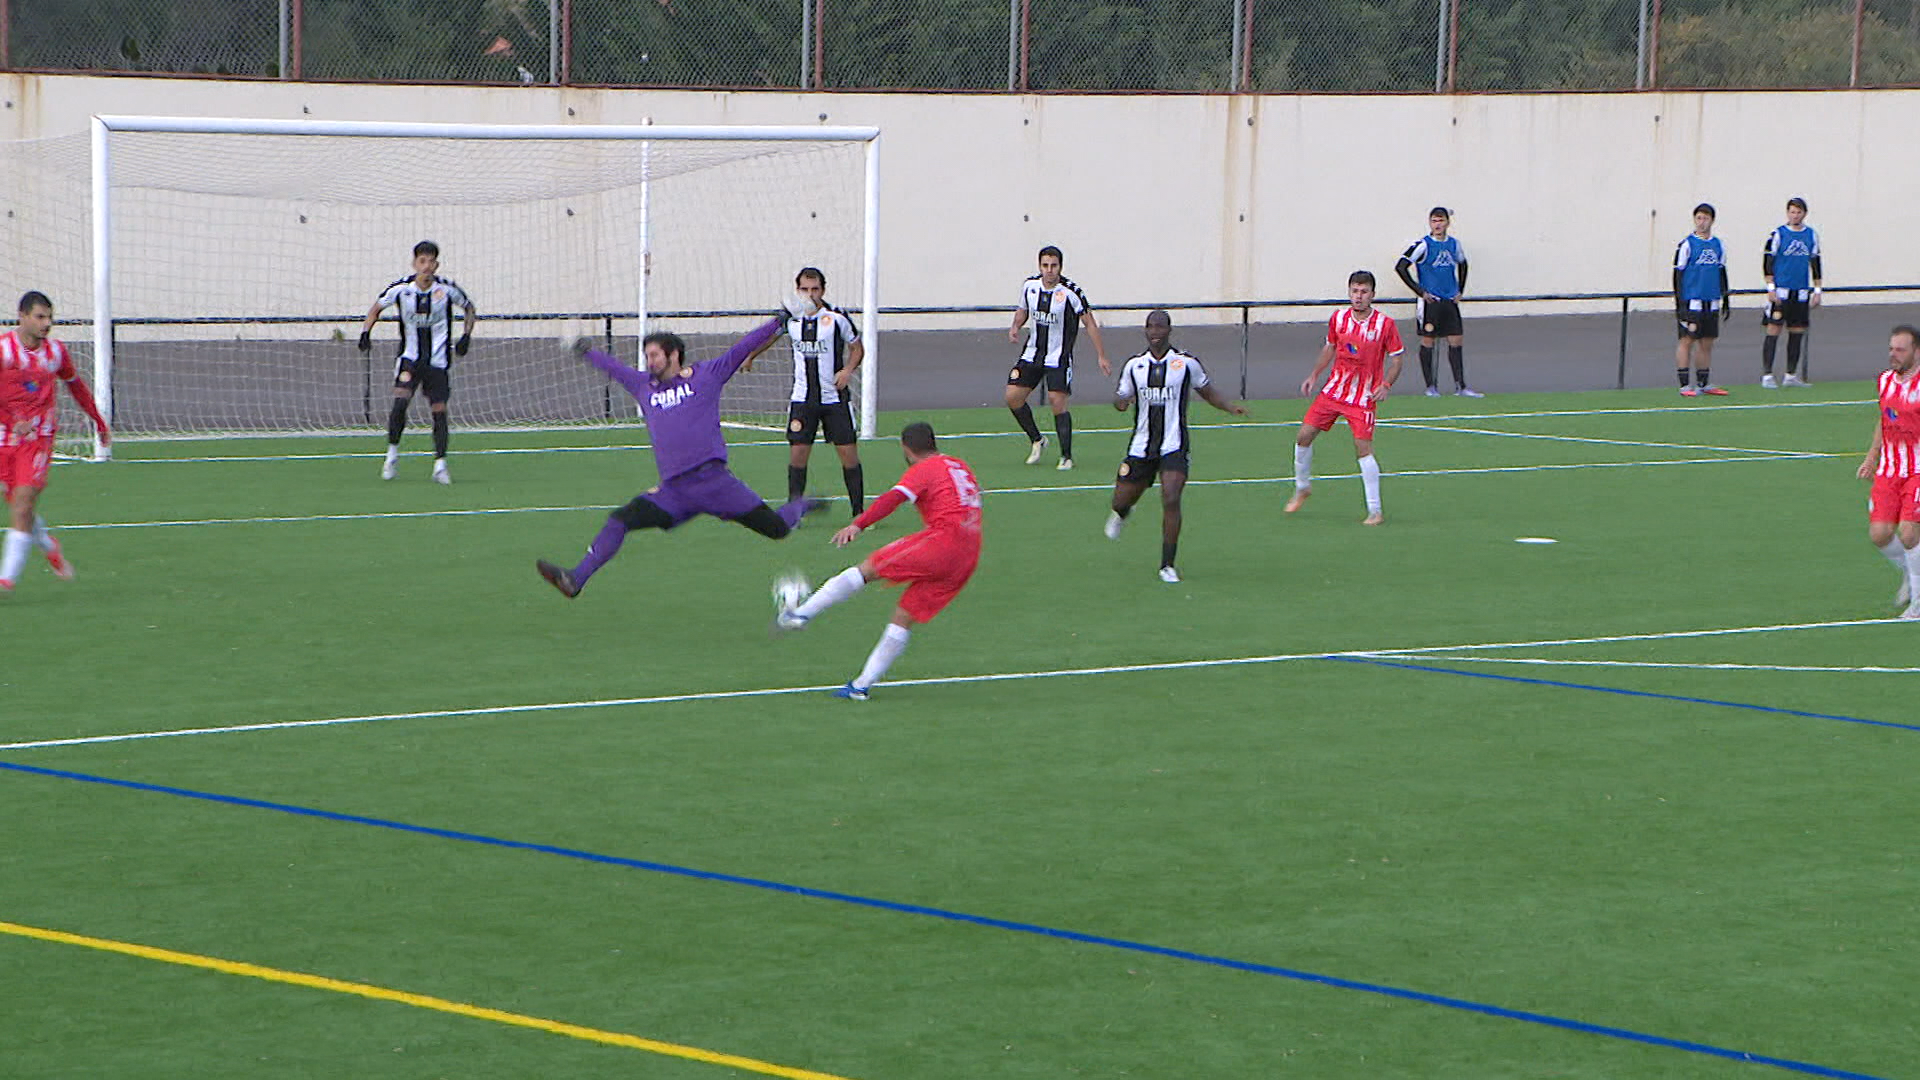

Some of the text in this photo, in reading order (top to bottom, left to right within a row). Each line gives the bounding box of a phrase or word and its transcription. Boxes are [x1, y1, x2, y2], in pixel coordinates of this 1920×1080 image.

[791, 340, 828, 353] CORAL
[650, 383, 695, 407] CORAL
[1138, 386, 1177, 400] CORAL
